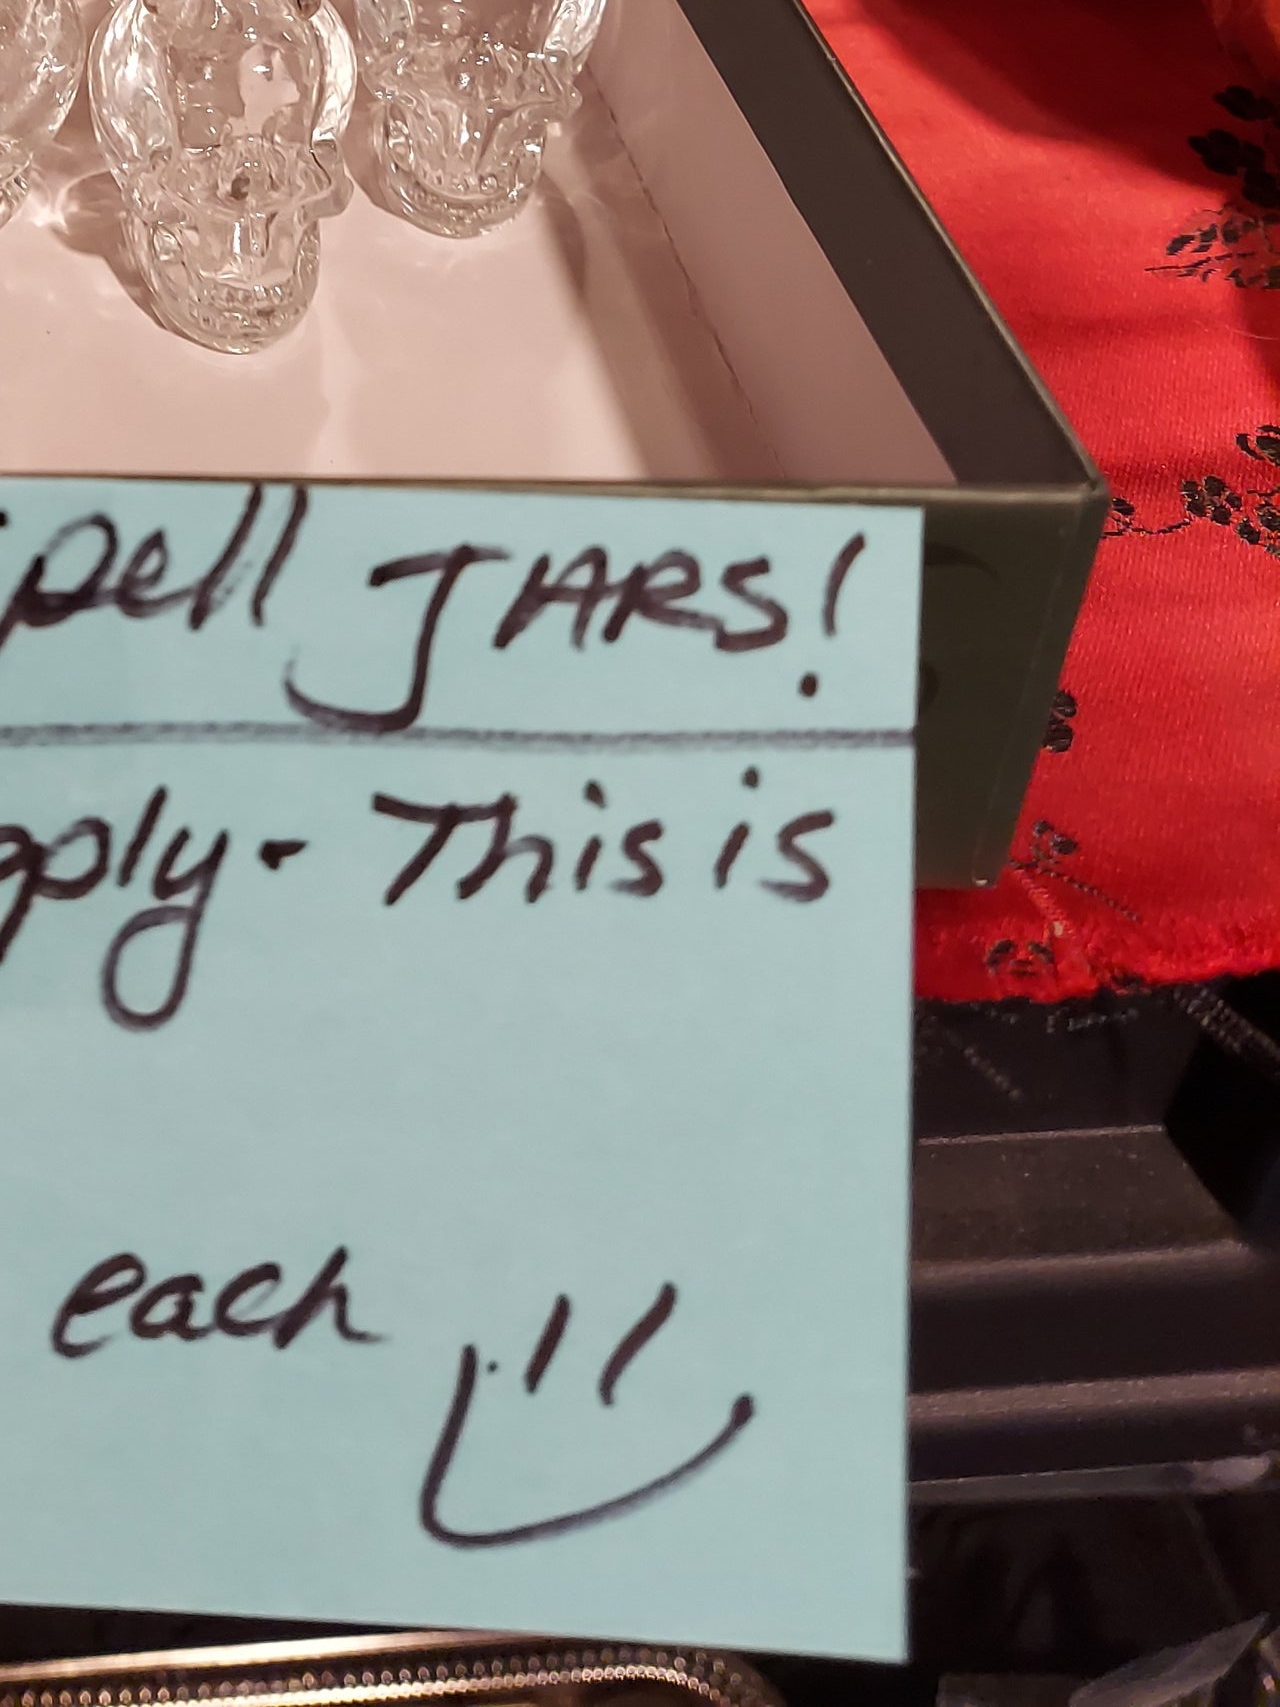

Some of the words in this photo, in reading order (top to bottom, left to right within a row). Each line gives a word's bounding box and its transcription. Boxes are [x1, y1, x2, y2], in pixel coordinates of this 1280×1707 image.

[371, 780, 665, 907] This
[714, 767, 835, 903] is
[50, 1245, 388, 1360] each
